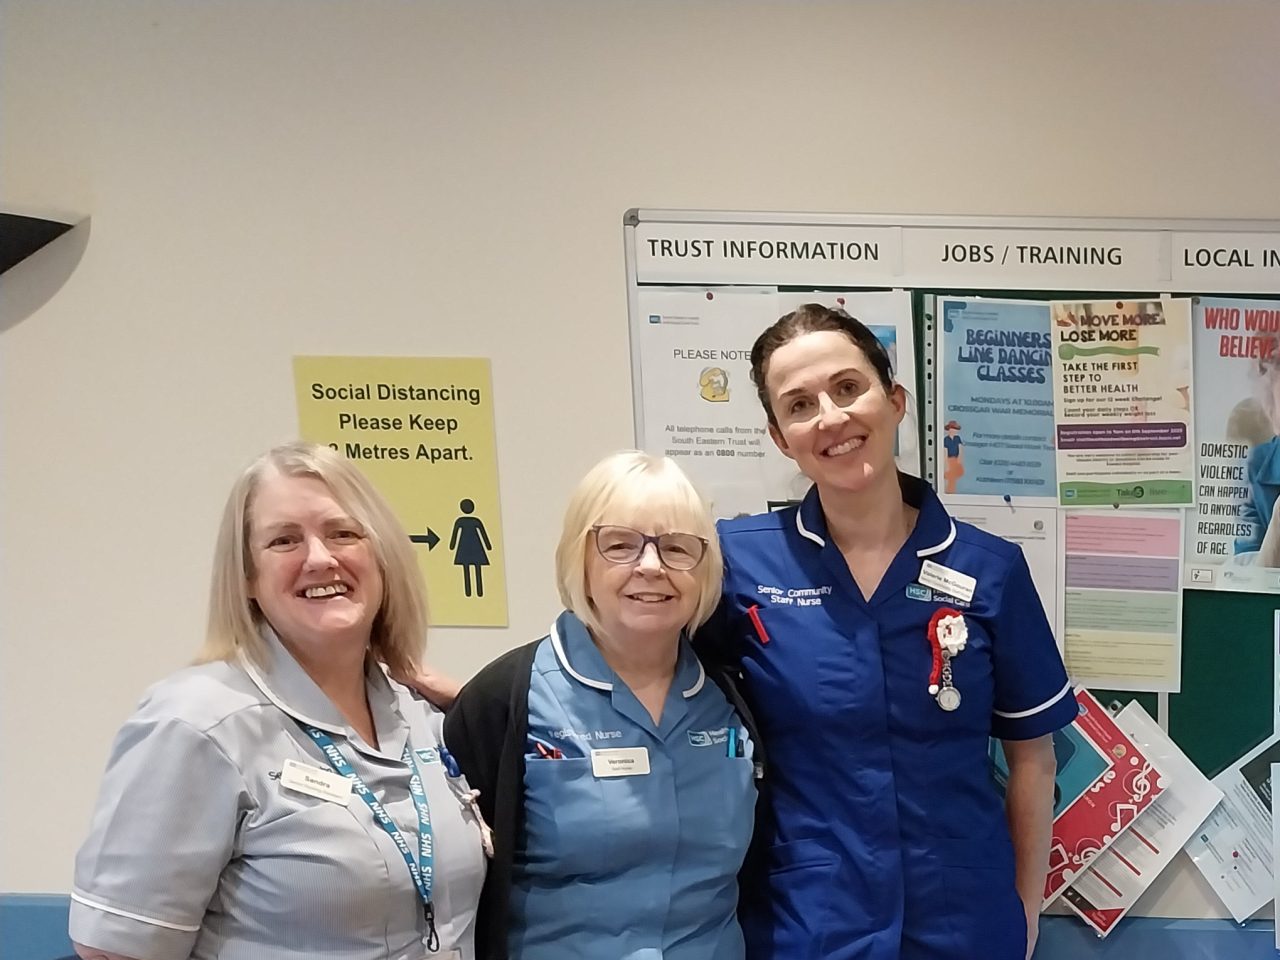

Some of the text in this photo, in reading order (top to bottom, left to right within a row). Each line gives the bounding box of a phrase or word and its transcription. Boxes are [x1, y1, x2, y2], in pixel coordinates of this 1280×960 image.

[647, 239, 879, 261] TRUST INFORMATION
[942, 244, 1122, 266] JOBS / TRAINING
[1184, 248, 1255, 267] LOCAL
[1080, 313, 1160, 327] MOVE MORE
[1205, 307, 1240, 331] WHO
[1060, 329, 1137, 342] LOSE MORE
[673, 349, 717, 360] PLEASE
[1219, 335, 1278, 359] BELIEVE
[998, 348, 1052, 366] DANCIN
[1063, 362, 1138, 371] TAKE THE FIRST
[977, 365, 1045, 384] CLASSES
[1063, 374, 1102, 383] STEP TO
[311, 383, 481, 405] Social Distancing
[1063, 384, 1139, 394] BETTER HEALTH
[339, 414, 458, 434] Please Keep
[677, 425, 714, 435] telephone
[716, 426, 733, 434] calls
[735, 426, 752, 434] from
[672, 437, 694, 445] South
[696, 438, 725, 446] Eastern
[727, 438, 746, 446] Trust
[345, 443, 410, 460] Metres
[416, 444, 473, 464] Apart.
[1201, 443, 1248, 458] DOMESTIC
[1200, 465, 1244, 480] VIOLENCE
[1199, 485, 1249, 499] CAN HAPPEN
[1199, 503, 1242, 516] TO ANYONE
[1198, 522, 1251, 537] REGARDLESS
[1197, 541, 1229, 555] OF AGE.
[757, 585, 832, 597] Senior Community
[771, 595, 822, 606] Staff Nurse
[595, 730, 622, 740] Nurse
[323, 744, 347, 767] NHS
[305, 775, 330, 788] Sandra
[346, 773, 370, 795] NHS
[370, 802, 391, 825] NHS
[417, 802, 430, 825] NHS
[391, 831, 409, 854] NHS
[421, 833, 432, 858] NHS
[409, 863, 423, 887] NHS
